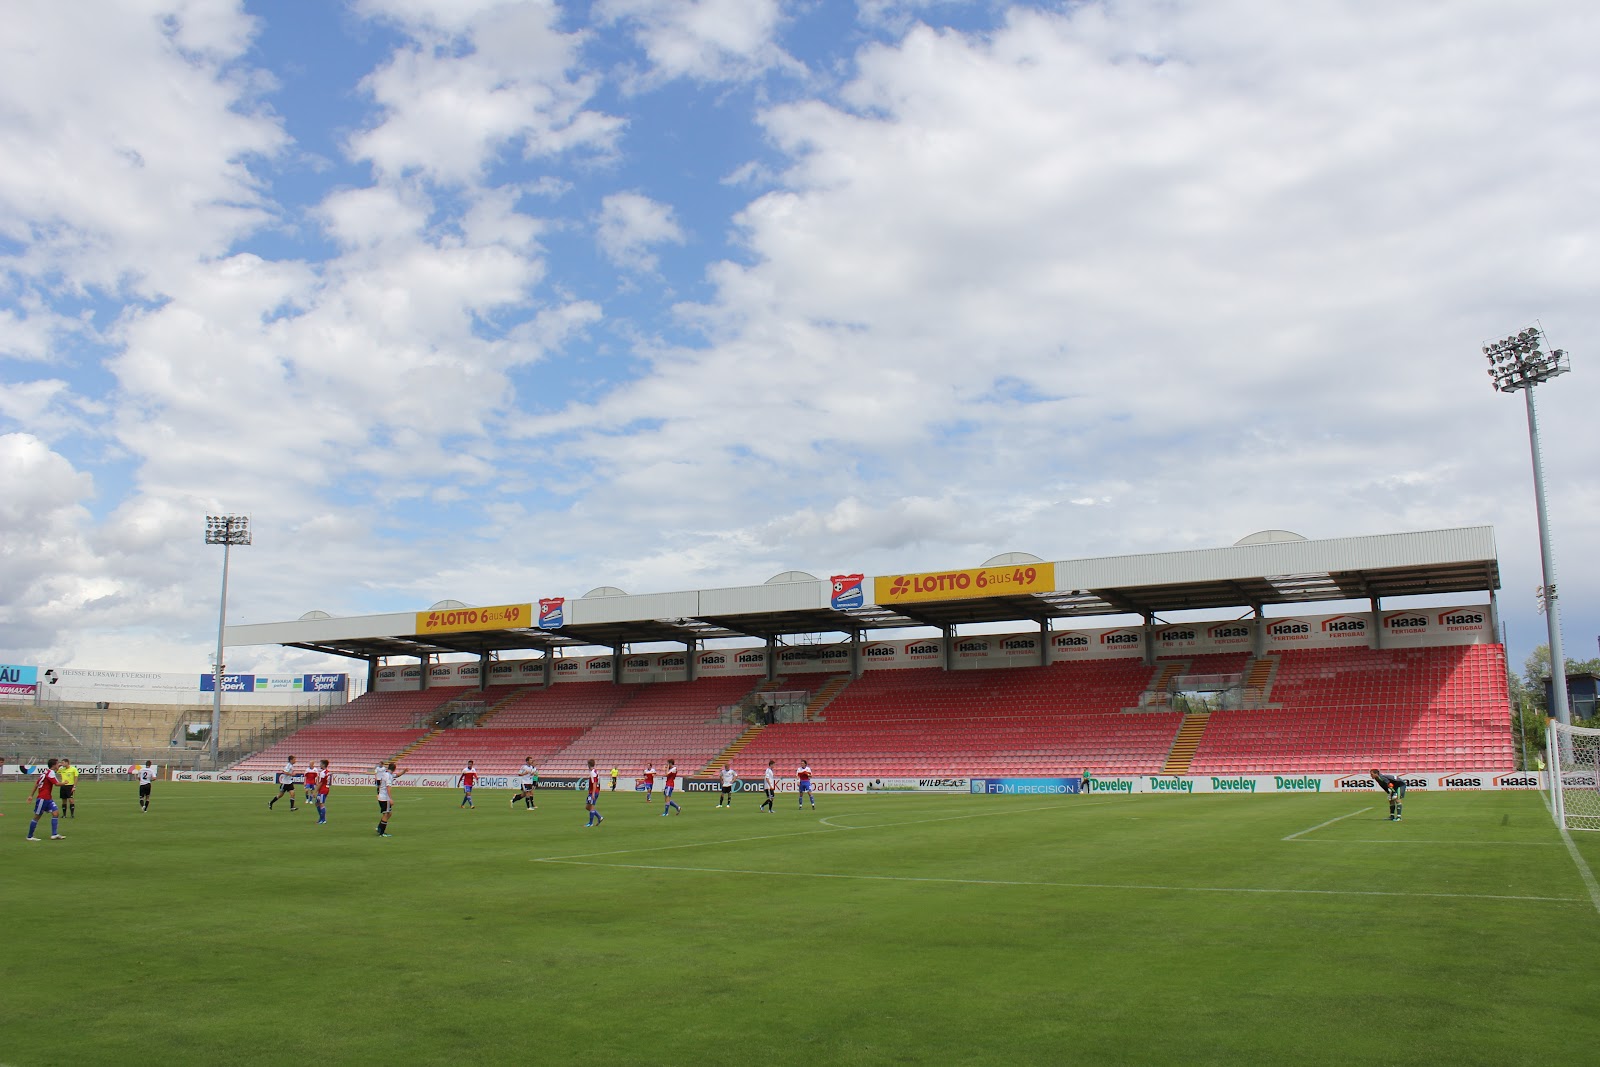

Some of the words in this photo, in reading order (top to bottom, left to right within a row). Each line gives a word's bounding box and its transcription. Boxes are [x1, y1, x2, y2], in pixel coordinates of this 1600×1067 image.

[914, 573, 970, 593] LOTTO
[441, 610, 477, 626] LOTTO
[1391, 616, 1427, 628] Haas
[1446, 614, 1483, 625] Haas
[1273, 623, 1309, 635] Haas
[1329, 620, 1365, 632] Haas
[1162, 630, 1195, 641] Haas
[1214, 626, 1248, 637] Haas
[1057, 636, 1088, 646] Haas
[1106, 634, 1138, 644] Haas
[959, 641, 988, 651] Haas
[1005, 639, 1035, 649] Haas
[822, 650, 848, 658] Haas
[867, 647, 895, 656] Haas
[911, 645, 939, 654] Haas
[662, 657, 685, 666] Haas
[702, 655, 725, 664] Haas
[739, 654, 764, 663] Haas
[557, 662, 577, 671] Haas
[590, 661, 611, 670] Haas
[432, 668, 450, 676] Haas
[460, 667, 479, 675] Haas
[311, 674, 339, 683] Fahrrad
[220, 682, 245, 691] Sperk
[314, 682, 335, 691] Sperk
[142, 772, 148, 780] 2
[1090, 778, 1133, 793] Develey
[1150, 777, 1193, 793] Develey
[1211, 776, 1256, 793] Develey
[1274, 776, 1321, 792] Develey
[1341, 779, 1375, 787] Haas
[1404, 779, 1427, 787] aas
[1446, 778, 1481, 787] Haas
[1501, 777, 1537, 786] Haas
[988, 784, 1015, 793] FDM
[1017, 785, 1074, 793] PRECISION
